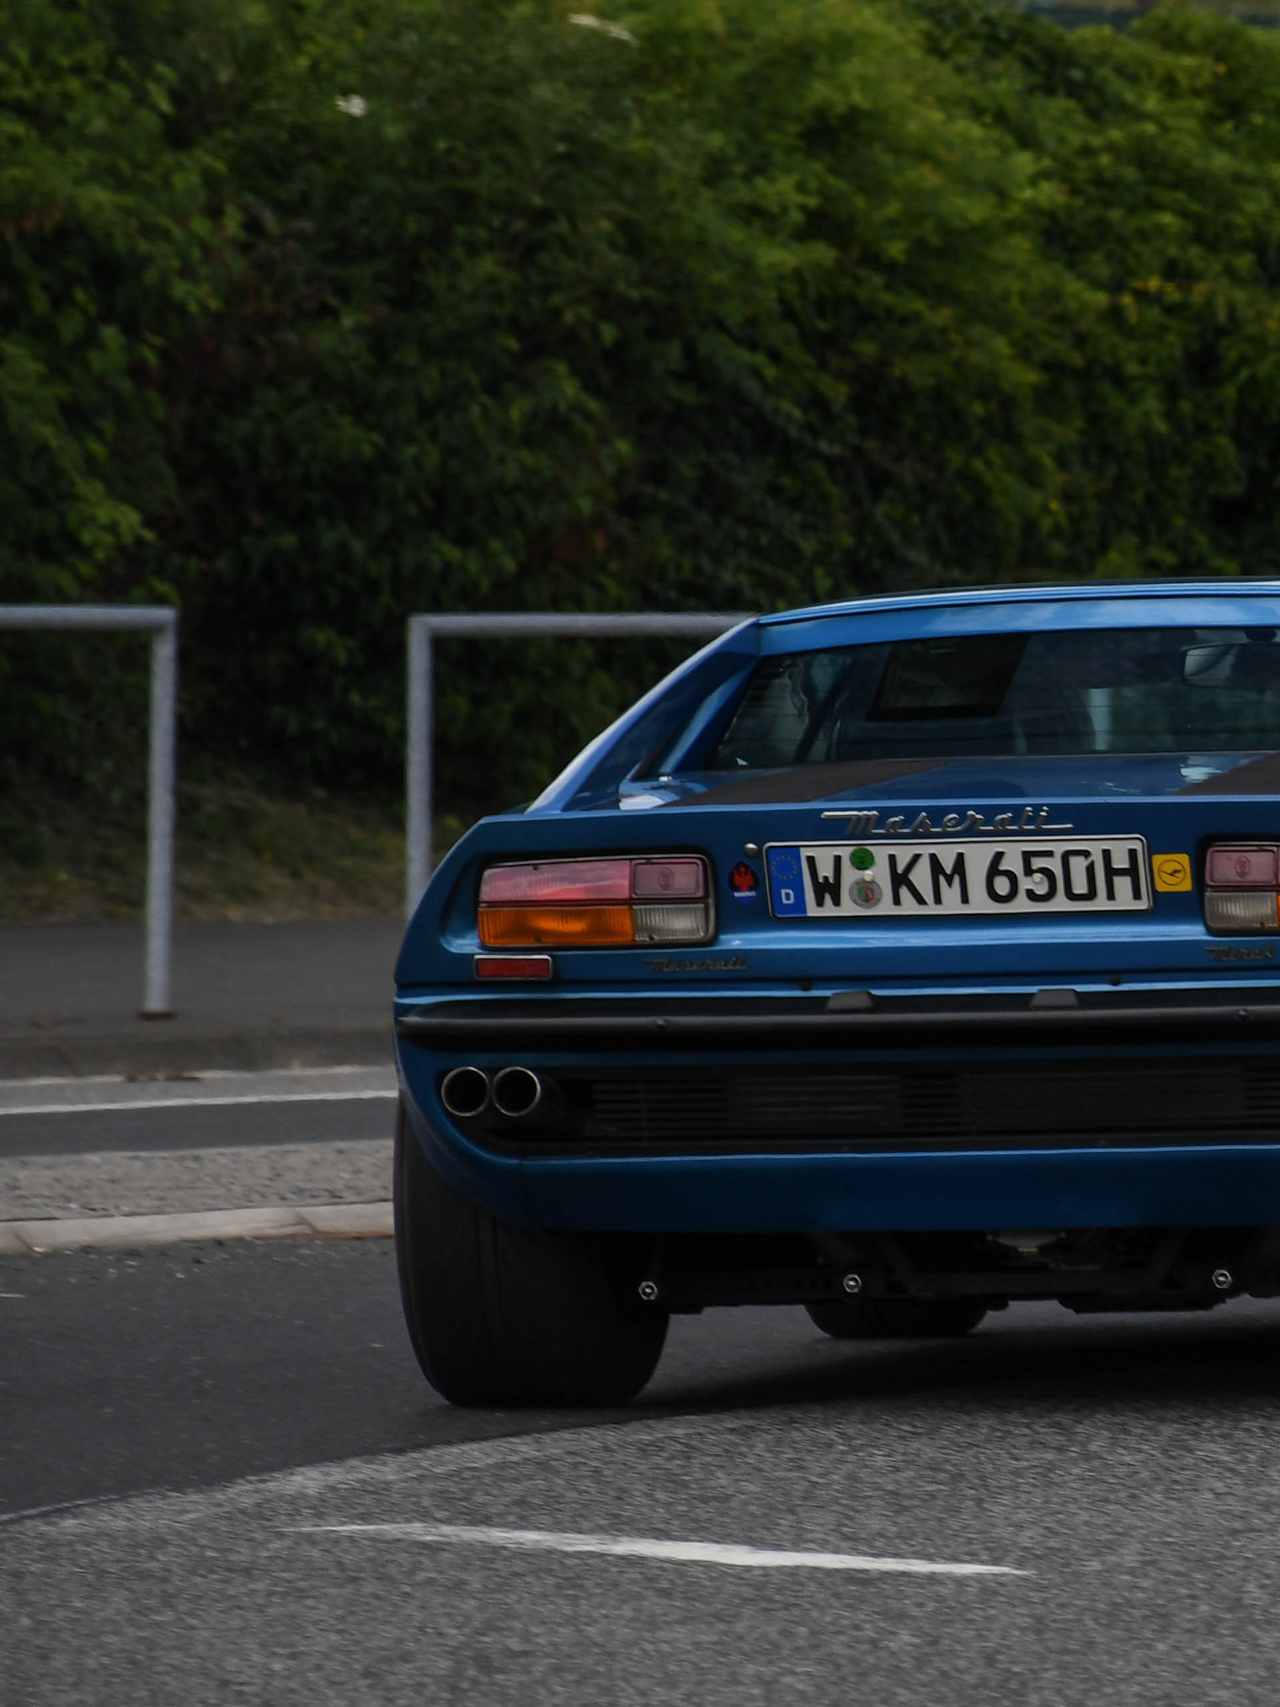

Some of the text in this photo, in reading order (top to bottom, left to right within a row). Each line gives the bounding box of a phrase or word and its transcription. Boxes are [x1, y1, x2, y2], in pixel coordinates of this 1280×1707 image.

[820, 806, 1074, 836] Maserati
[805, 847, 1143, 908] W KM 650H
[780, 888, 796, 905] D
